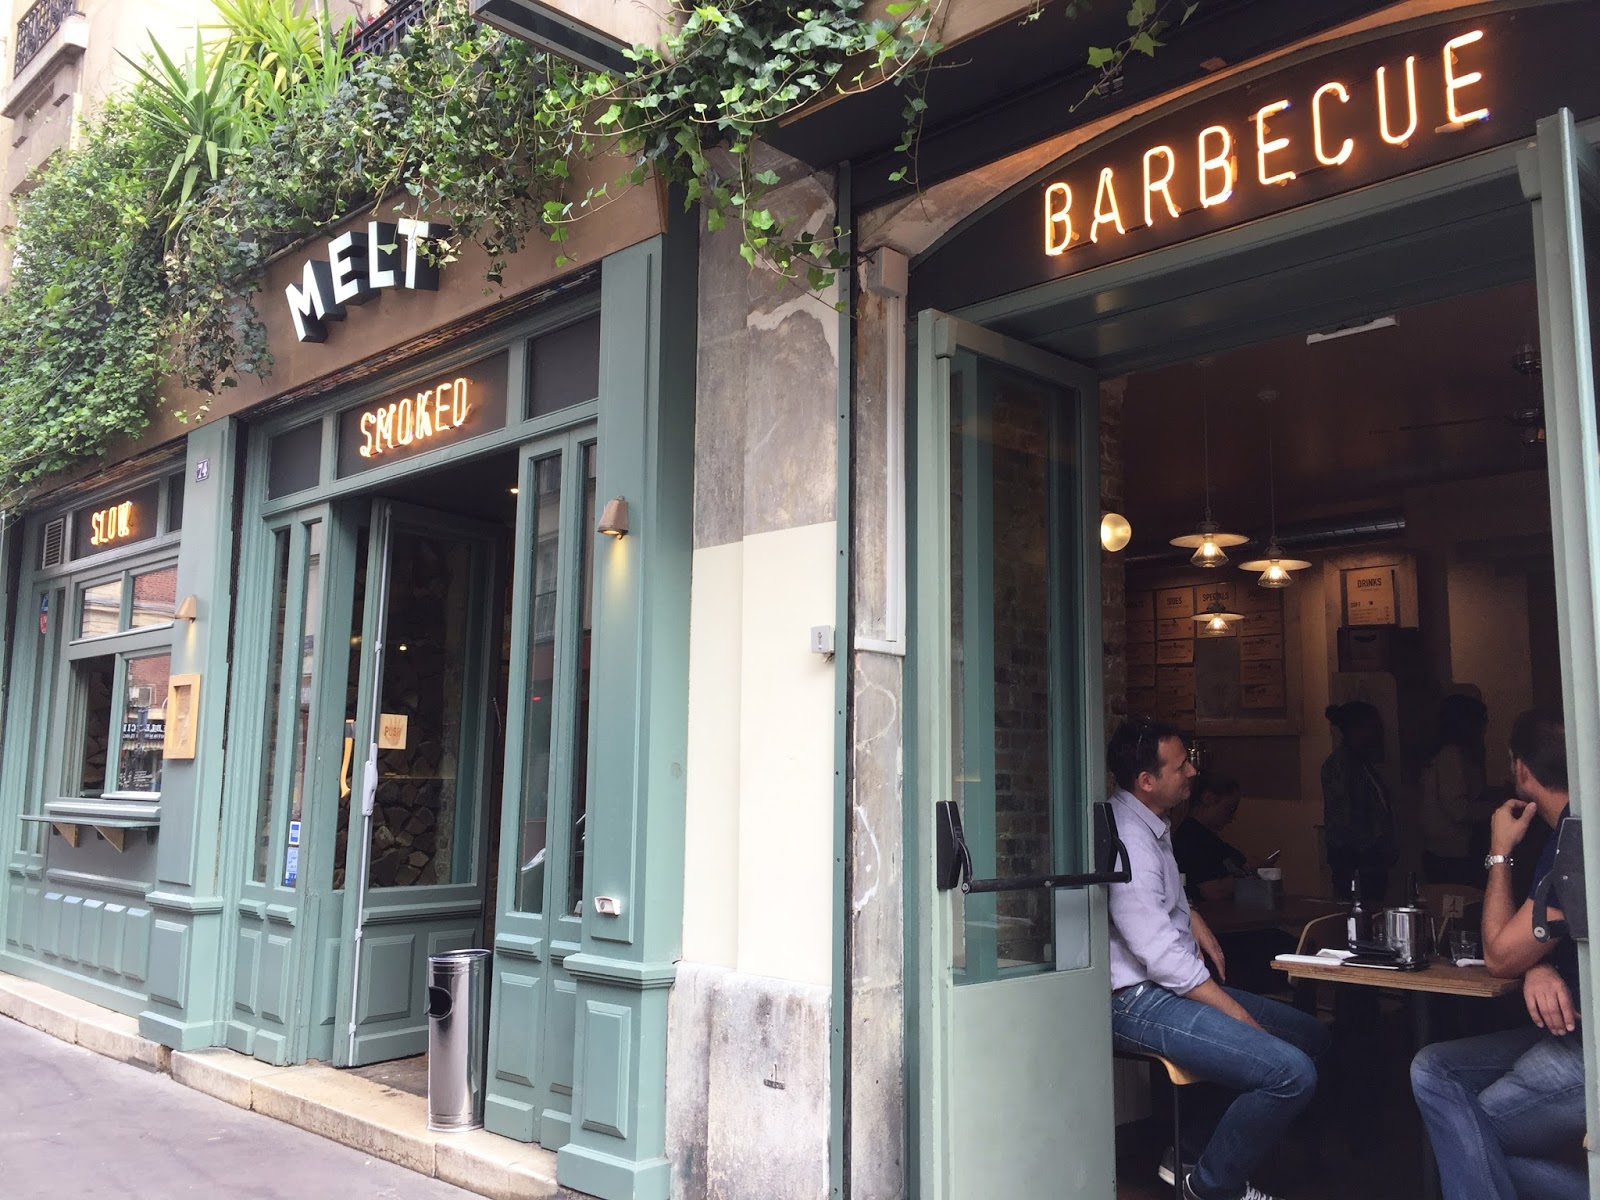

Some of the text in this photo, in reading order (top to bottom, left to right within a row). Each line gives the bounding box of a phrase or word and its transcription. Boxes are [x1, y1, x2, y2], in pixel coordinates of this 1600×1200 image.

[1044, 30, 1490, 256] BARBECUE
[285, 218, 432, 342] MELT
[360, 377, 468, 457] SMOKED
[90, 500, 133, 546] SLOW
[1166, 597, 1183, 606] SIDES
[1357, 577, 1382, 588] DRINKS
[383, 726, 402, 737] PUSH
